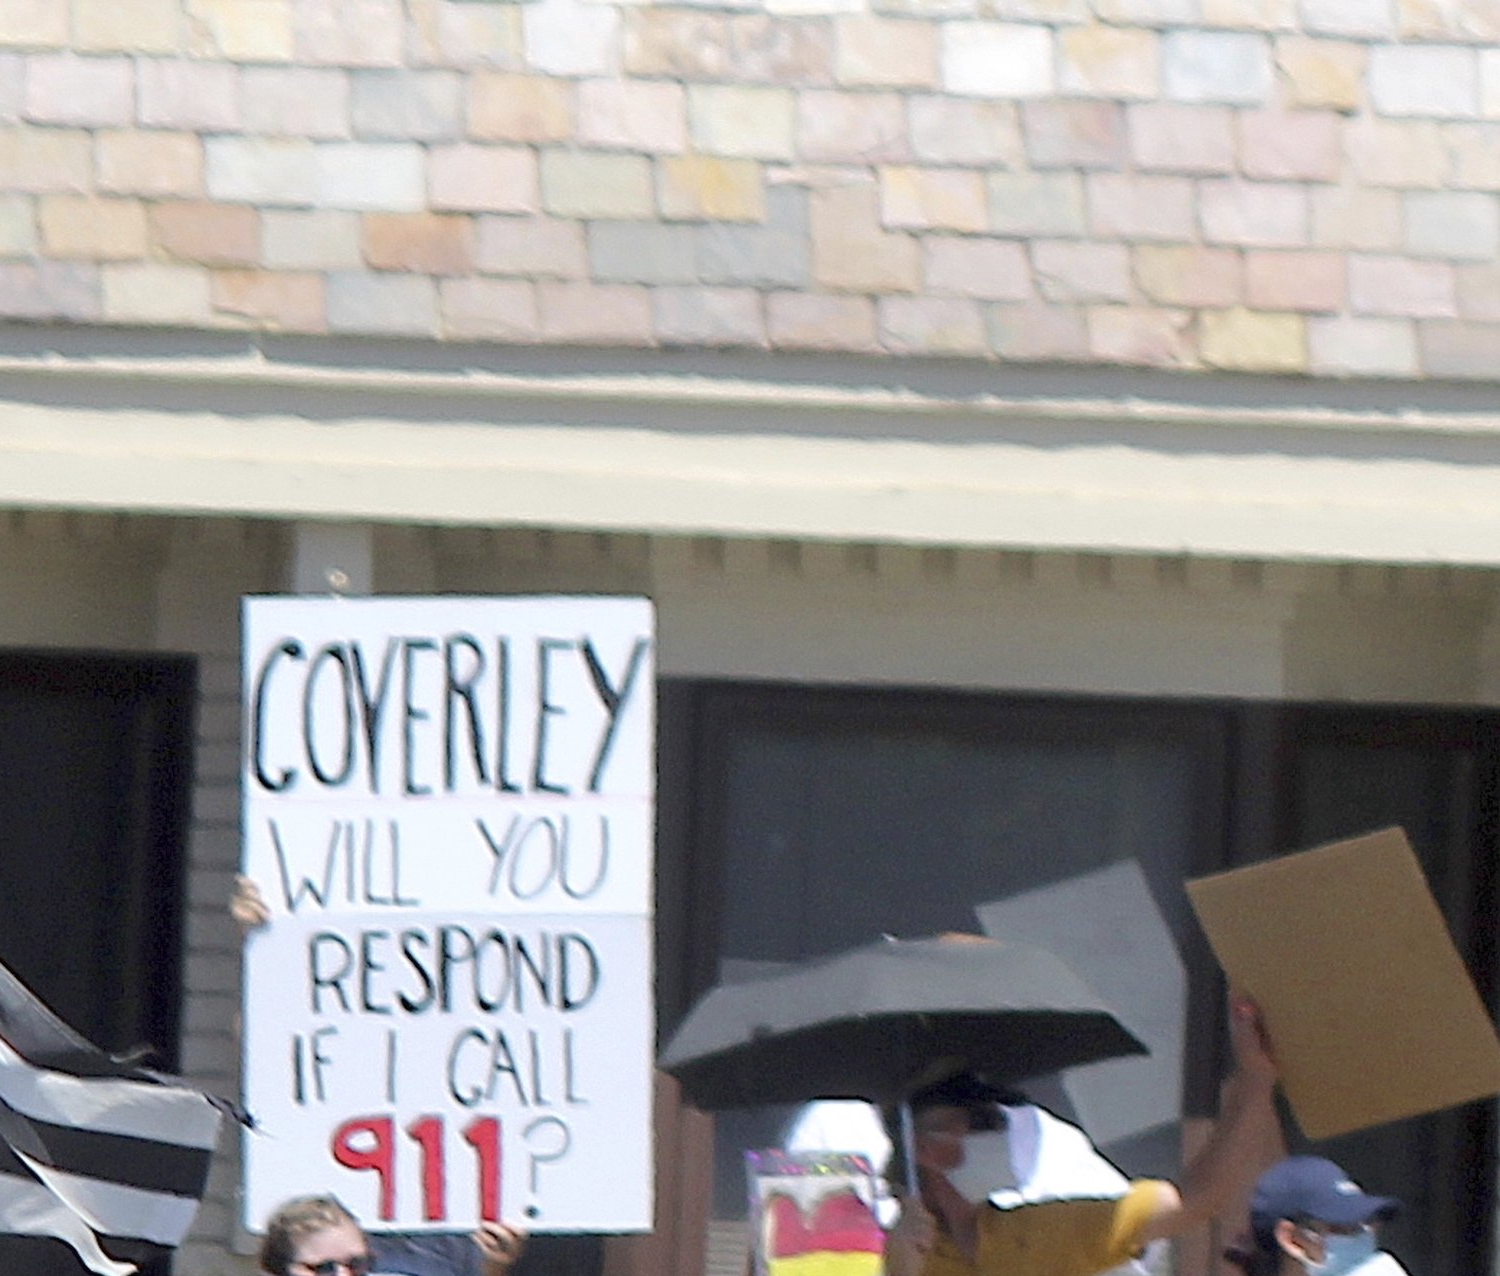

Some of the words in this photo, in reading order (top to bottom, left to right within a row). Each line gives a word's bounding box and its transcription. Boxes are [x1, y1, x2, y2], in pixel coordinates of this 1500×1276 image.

[251, 632, 651, 796] COVERLEY
[268, 816, 420, 911] WILL
[475, 814, 610, 901] YOU
[307, 923, 602, 1015] RESPOND
[292, 1025, 339, 1107] IF
[385, 1027, 397, 1106] I
[446, 1026, 588, 1109] CALL
[332, 1112, 573, 1223] 911?
